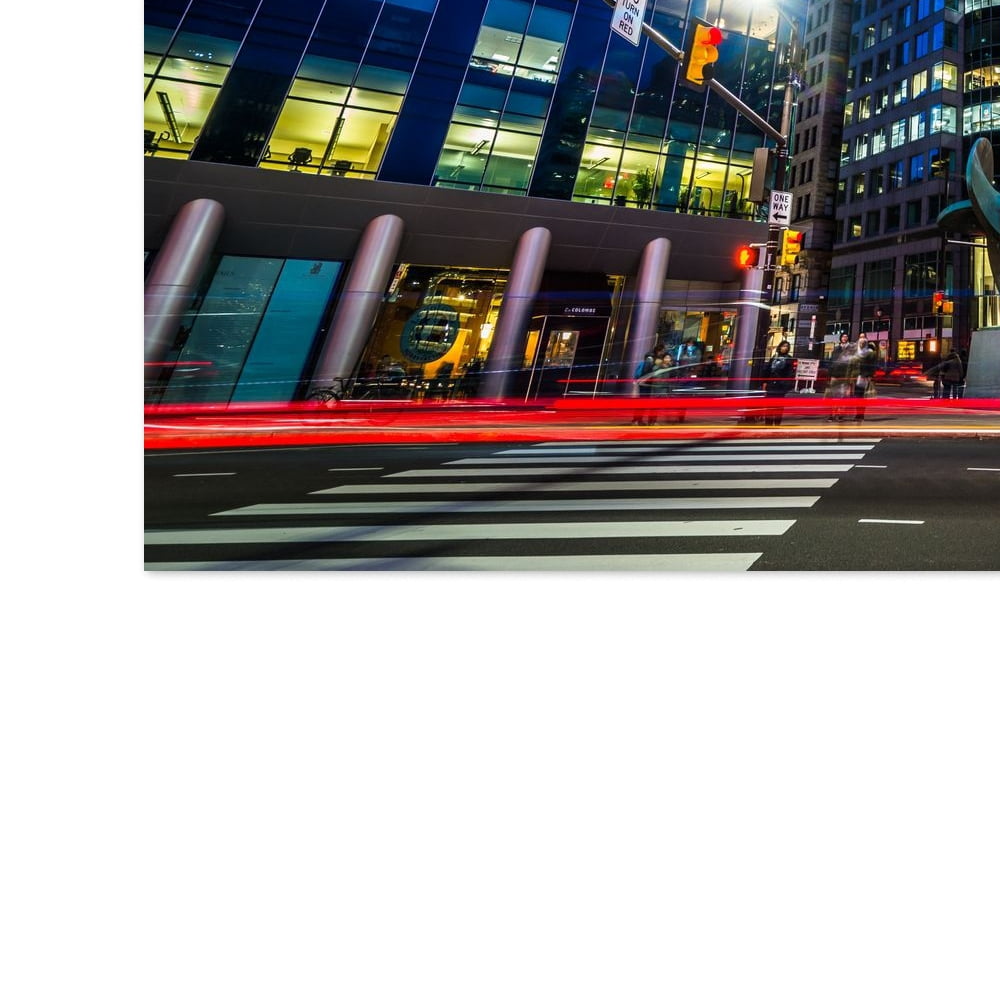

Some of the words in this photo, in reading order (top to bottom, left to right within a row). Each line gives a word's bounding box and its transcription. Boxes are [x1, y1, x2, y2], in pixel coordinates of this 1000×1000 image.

[623, 11, 634, 25] ON
[618, 20, 633, 36] RED
[774, 193, 789, 203] ONE
[772, 202, 789, 212] WAY
